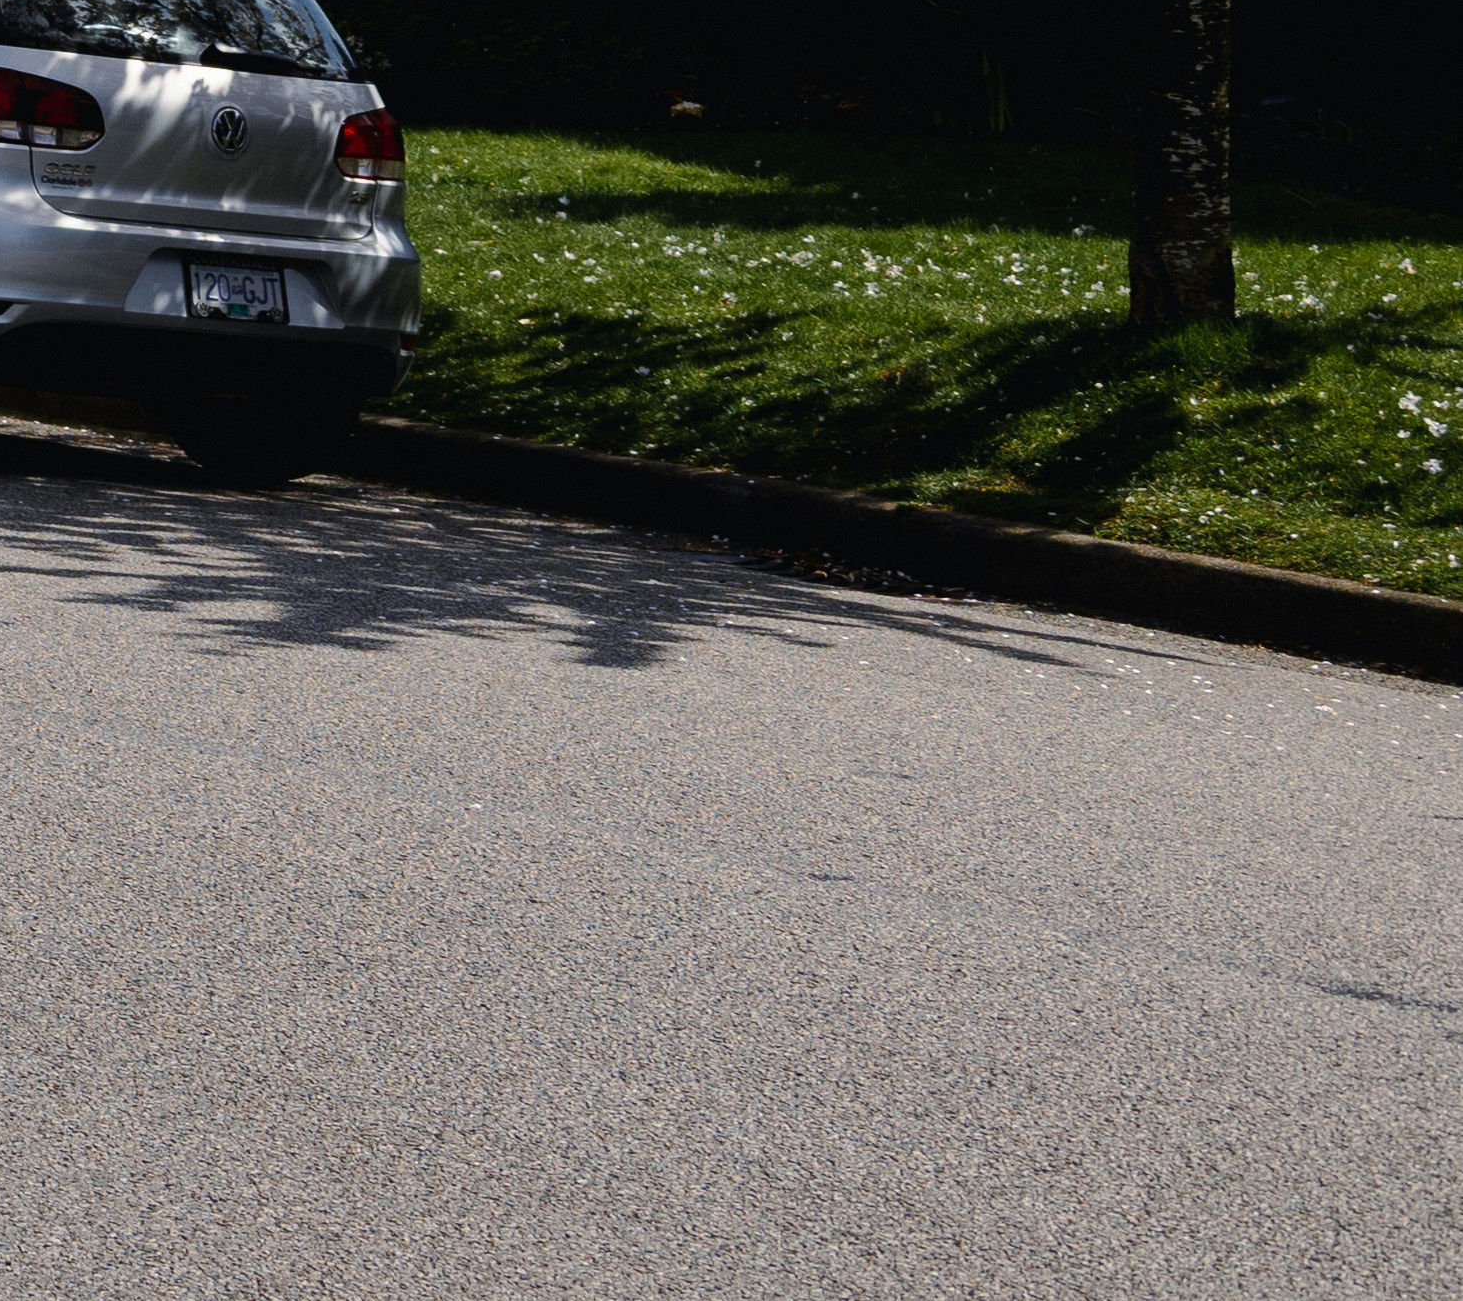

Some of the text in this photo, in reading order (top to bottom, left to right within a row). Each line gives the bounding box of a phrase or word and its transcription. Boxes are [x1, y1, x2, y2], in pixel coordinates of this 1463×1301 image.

[44, 161, 96, 176] GOLF
[194, 271, 279, 307] 120 GJT
